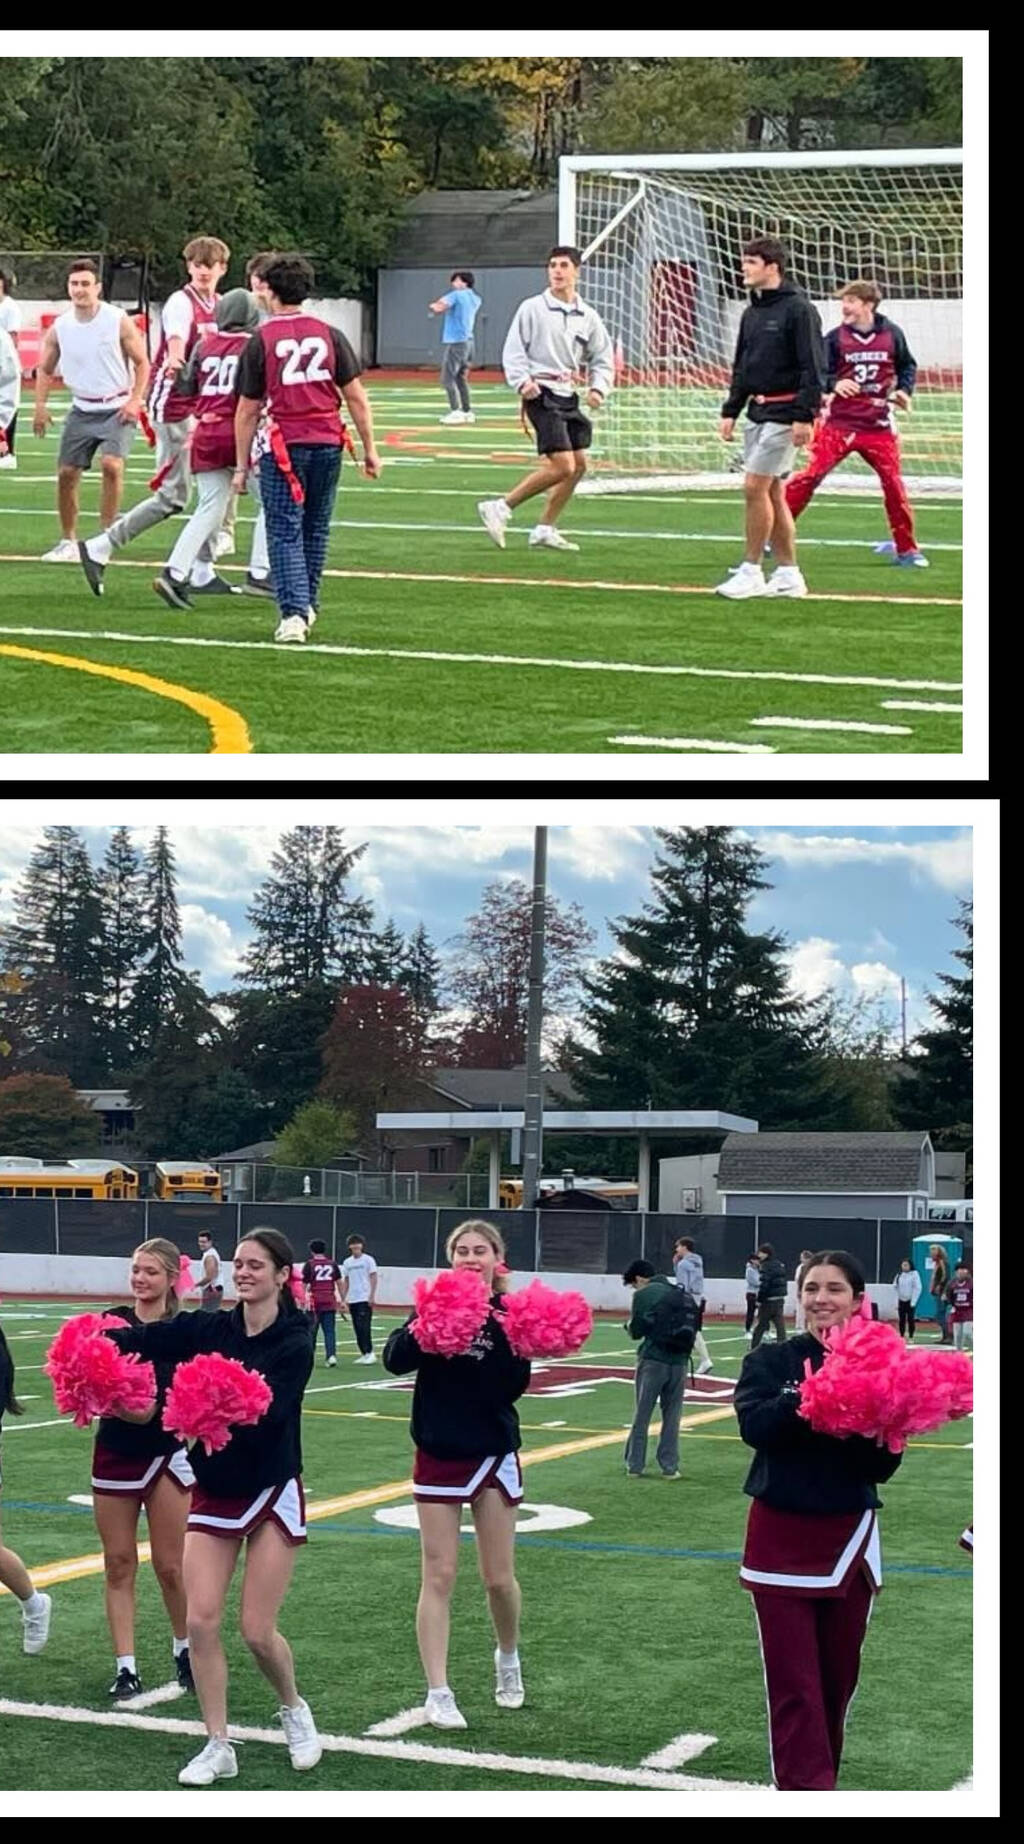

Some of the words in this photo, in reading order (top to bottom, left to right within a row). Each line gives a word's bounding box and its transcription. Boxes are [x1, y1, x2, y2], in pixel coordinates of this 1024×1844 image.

[201, 355, 239, 396] 20
[276, 337, 332, 386] 22
[314, 1264, 333, 1281] 22
